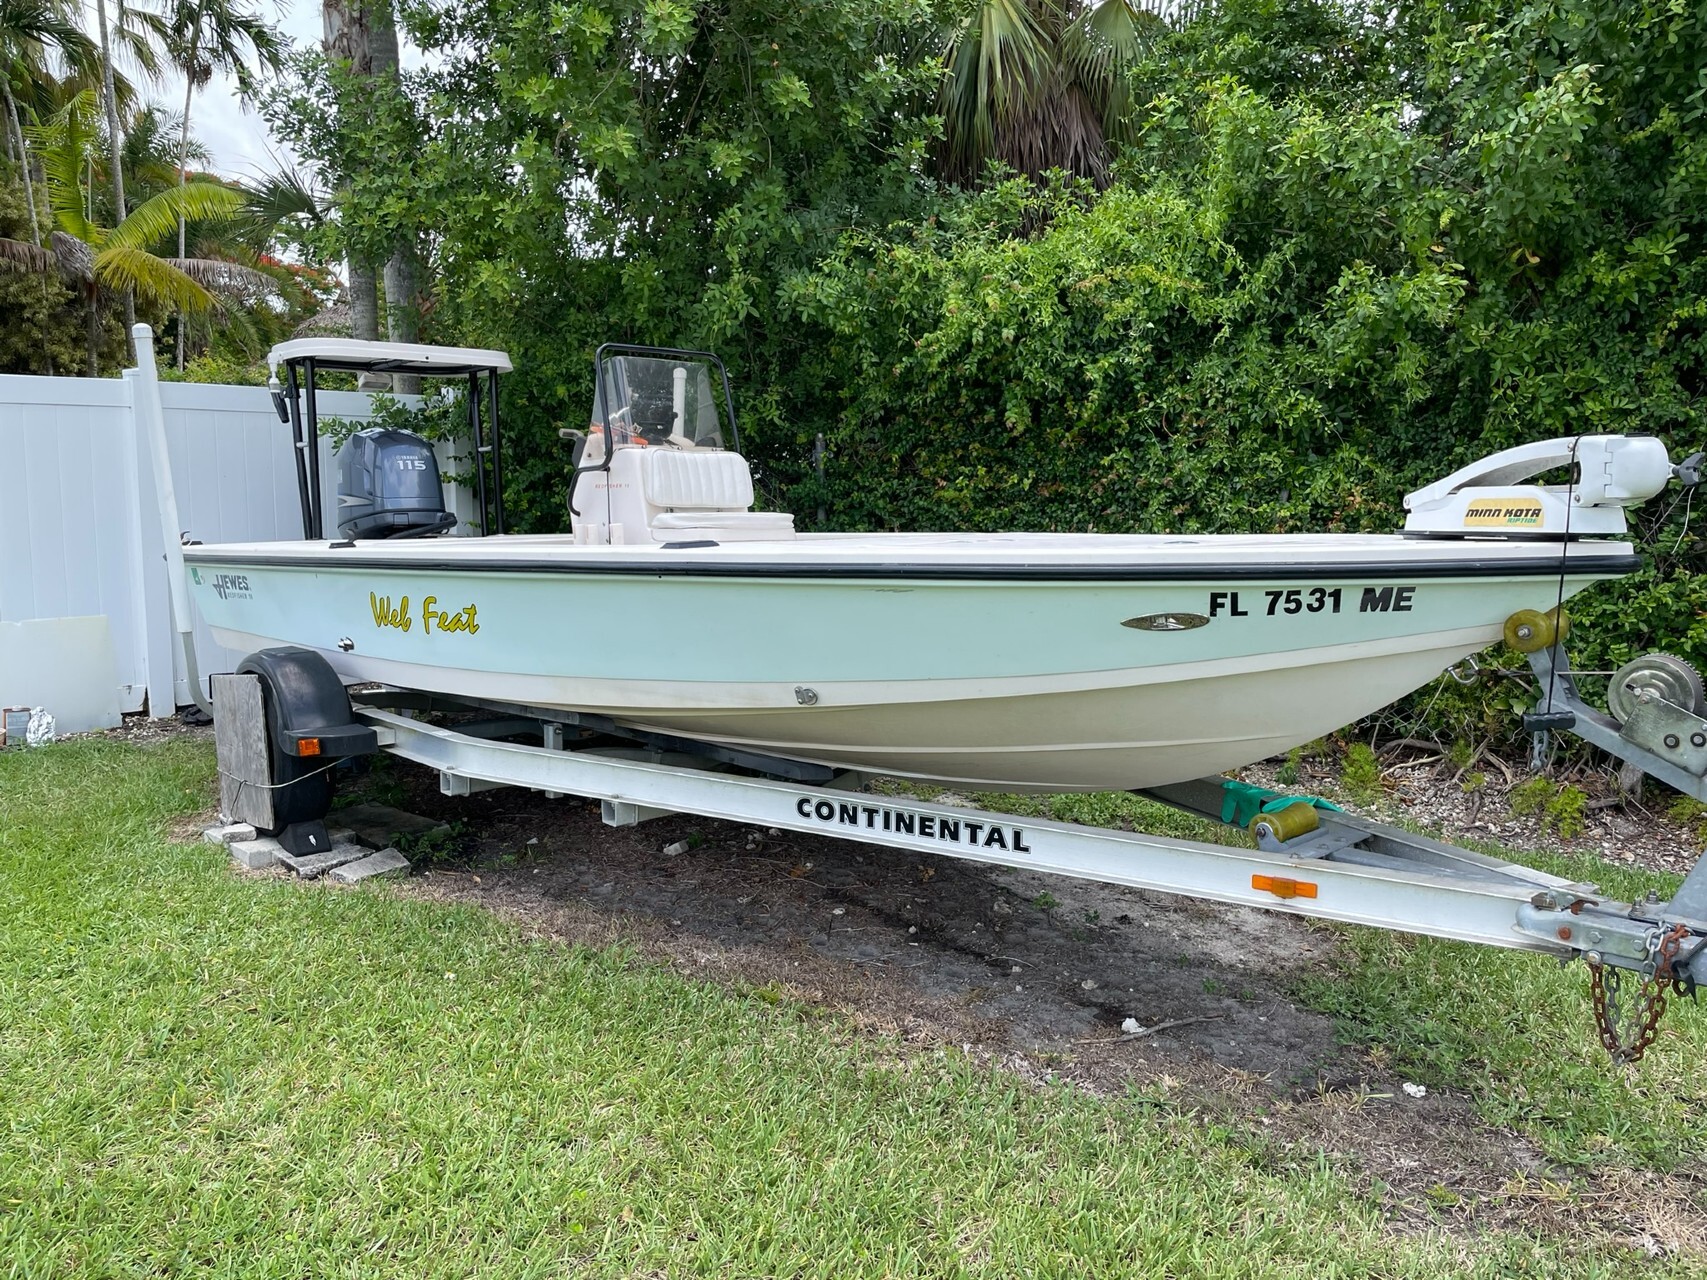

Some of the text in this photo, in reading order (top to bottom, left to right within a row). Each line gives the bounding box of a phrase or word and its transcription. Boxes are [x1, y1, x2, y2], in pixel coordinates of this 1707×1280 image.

[396, 460, 427, 470] 115
[1465, 508, 1542, 518] MINN KOTA
[212, 574, 250, 600] HEWES
[370, 591, 480, 635] Web Feat
[1209, 586, 1417, 618] FL 7531 ME
[796, 796, 1031, 854] CONTINENTAL
